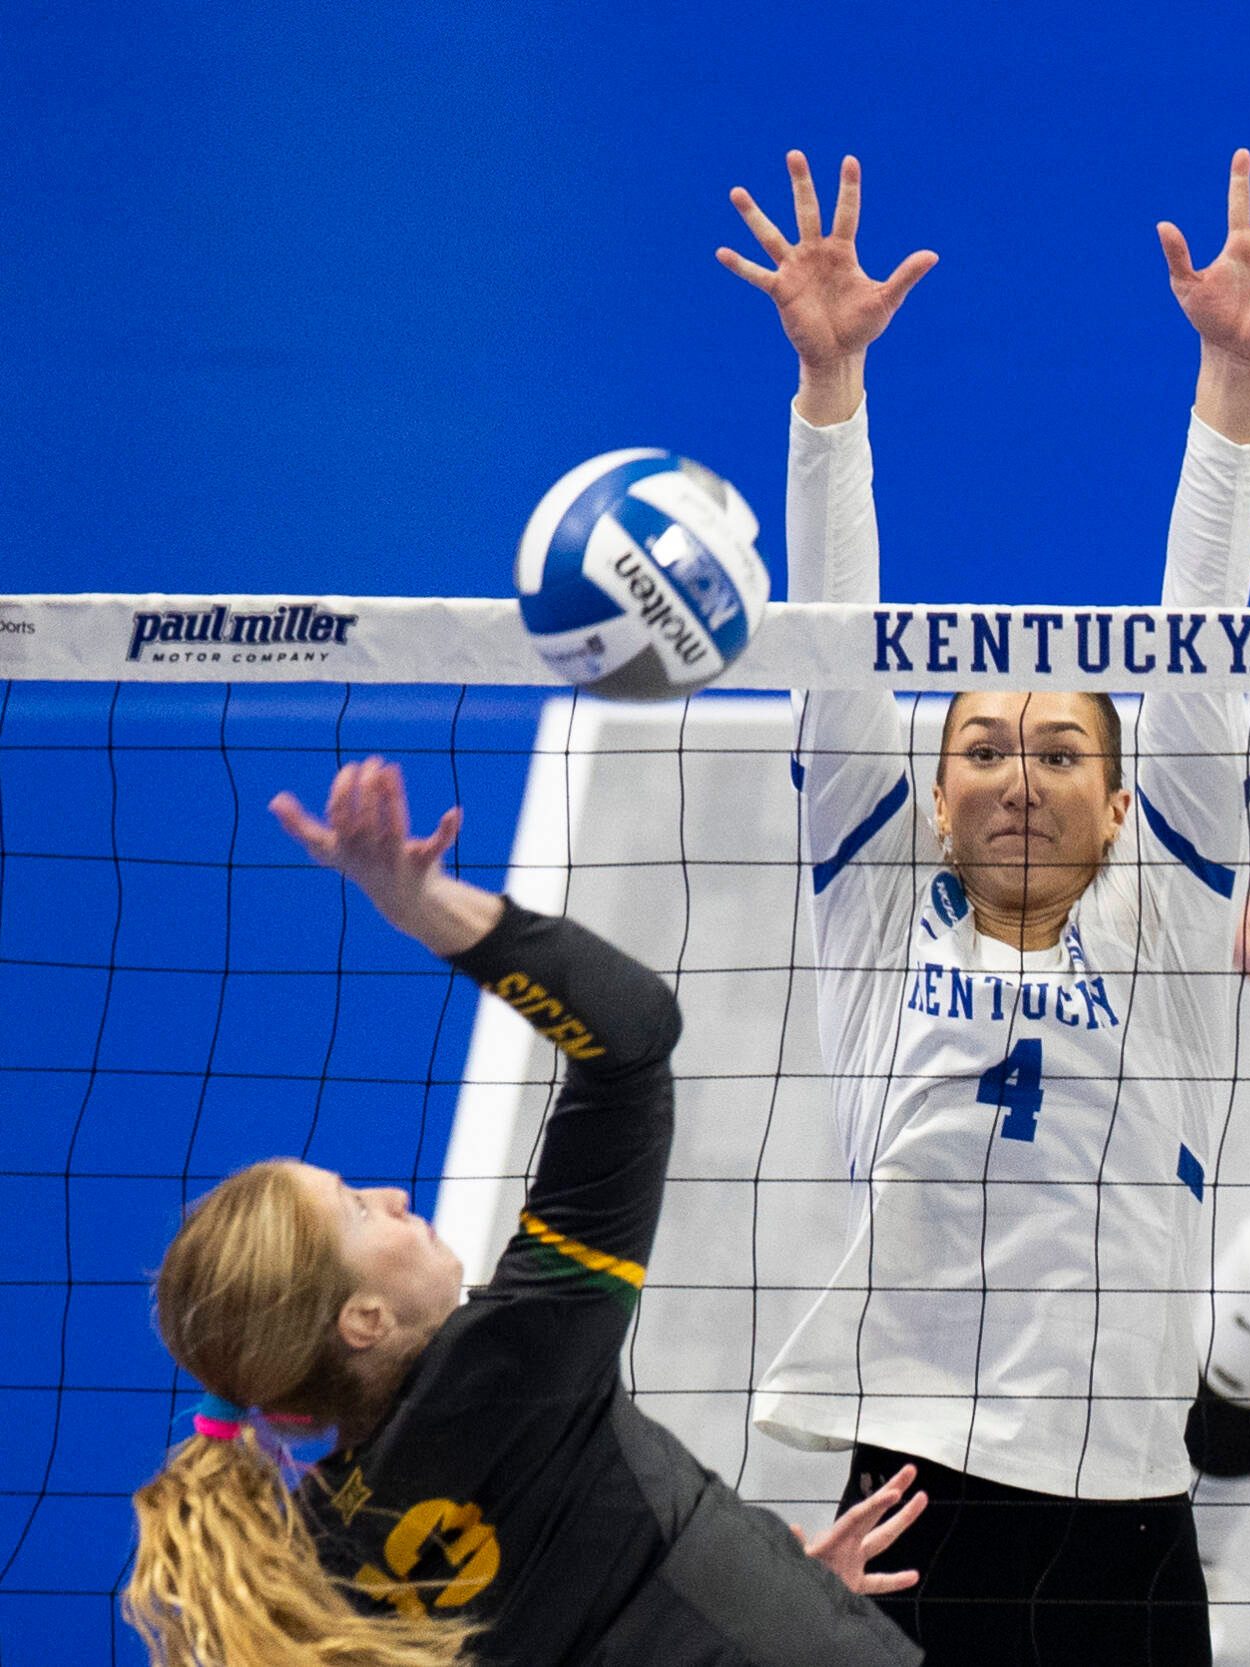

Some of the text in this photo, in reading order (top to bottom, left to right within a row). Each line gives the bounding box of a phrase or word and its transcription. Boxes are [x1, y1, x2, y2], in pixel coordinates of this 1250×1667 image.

[126, 603, 359, 662] paul miller
[614, 552, 708, 667] molten
[152, 651, 331, 663] MOTOR COMPANY
[975, 1037, 1044, 1142] 4
